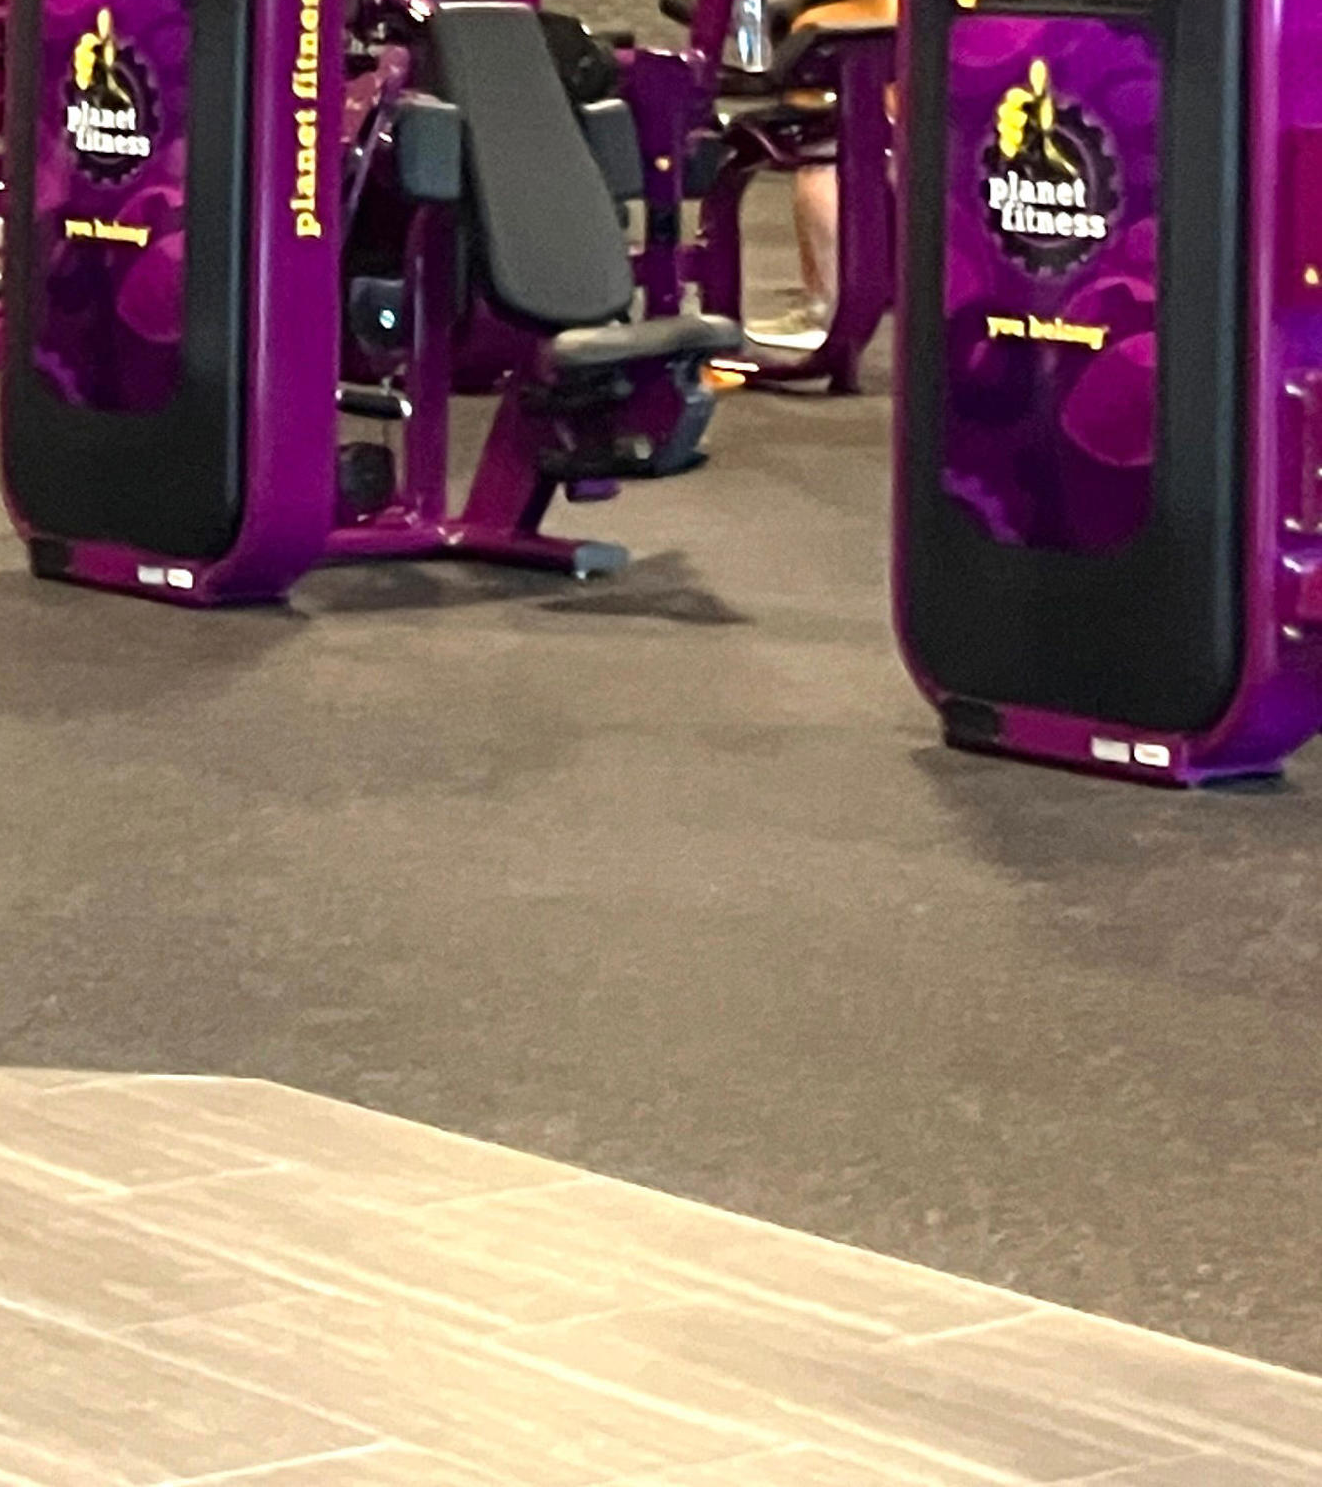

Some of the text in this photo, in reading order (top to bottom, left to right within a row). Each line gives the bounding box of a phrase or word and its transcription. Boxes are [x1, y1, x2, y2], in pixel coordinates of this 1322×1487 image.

[67, 101, 136, 132] planet
[76, 128, 151, 157] fitness
[289, 110, 322, 239] planet
[988, 171, 1086, 209] planet
[1001, 203, 1107, 239] fitness
